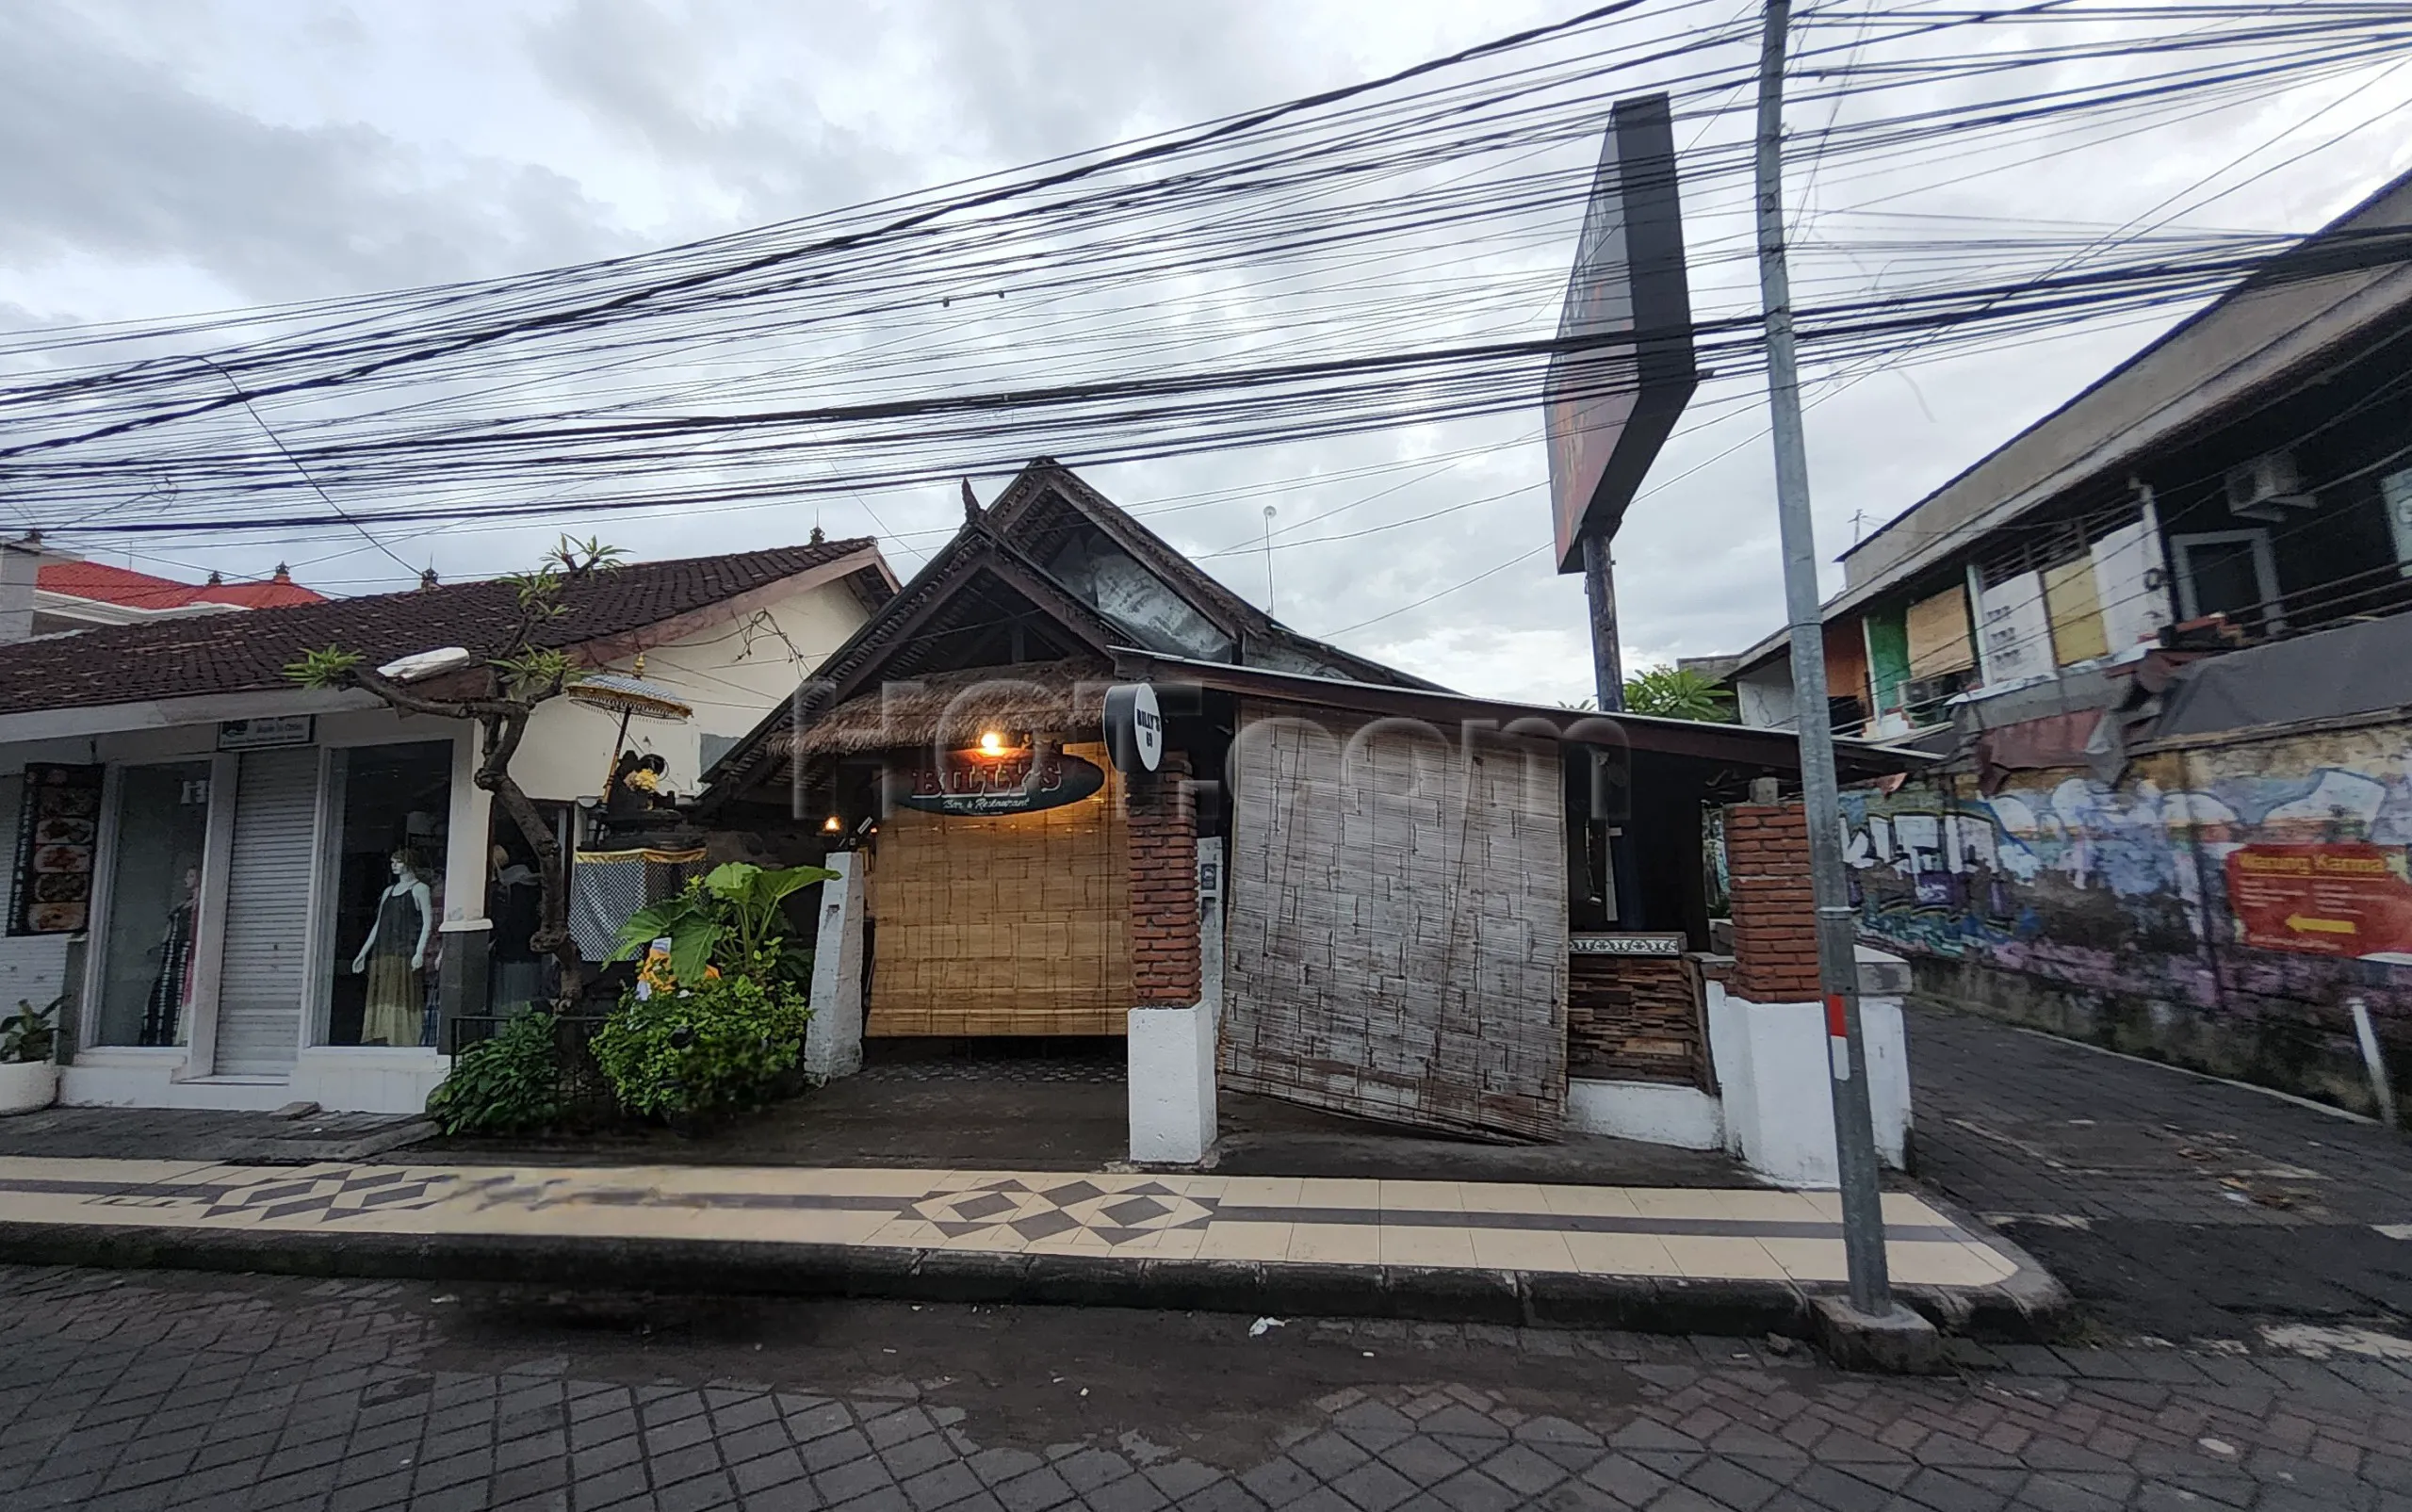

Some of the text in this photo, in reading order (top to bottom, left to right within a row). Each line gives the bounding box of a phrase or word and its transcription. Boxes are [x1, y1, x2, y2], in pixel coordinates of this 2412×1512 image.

[1136, 707, 1161, 733] BILLY'S
[911, 761, 1063, 799] BILLY'S
[943, 799, 963, 809] Bar
[975, 797, 1030, 810] Restaurant
